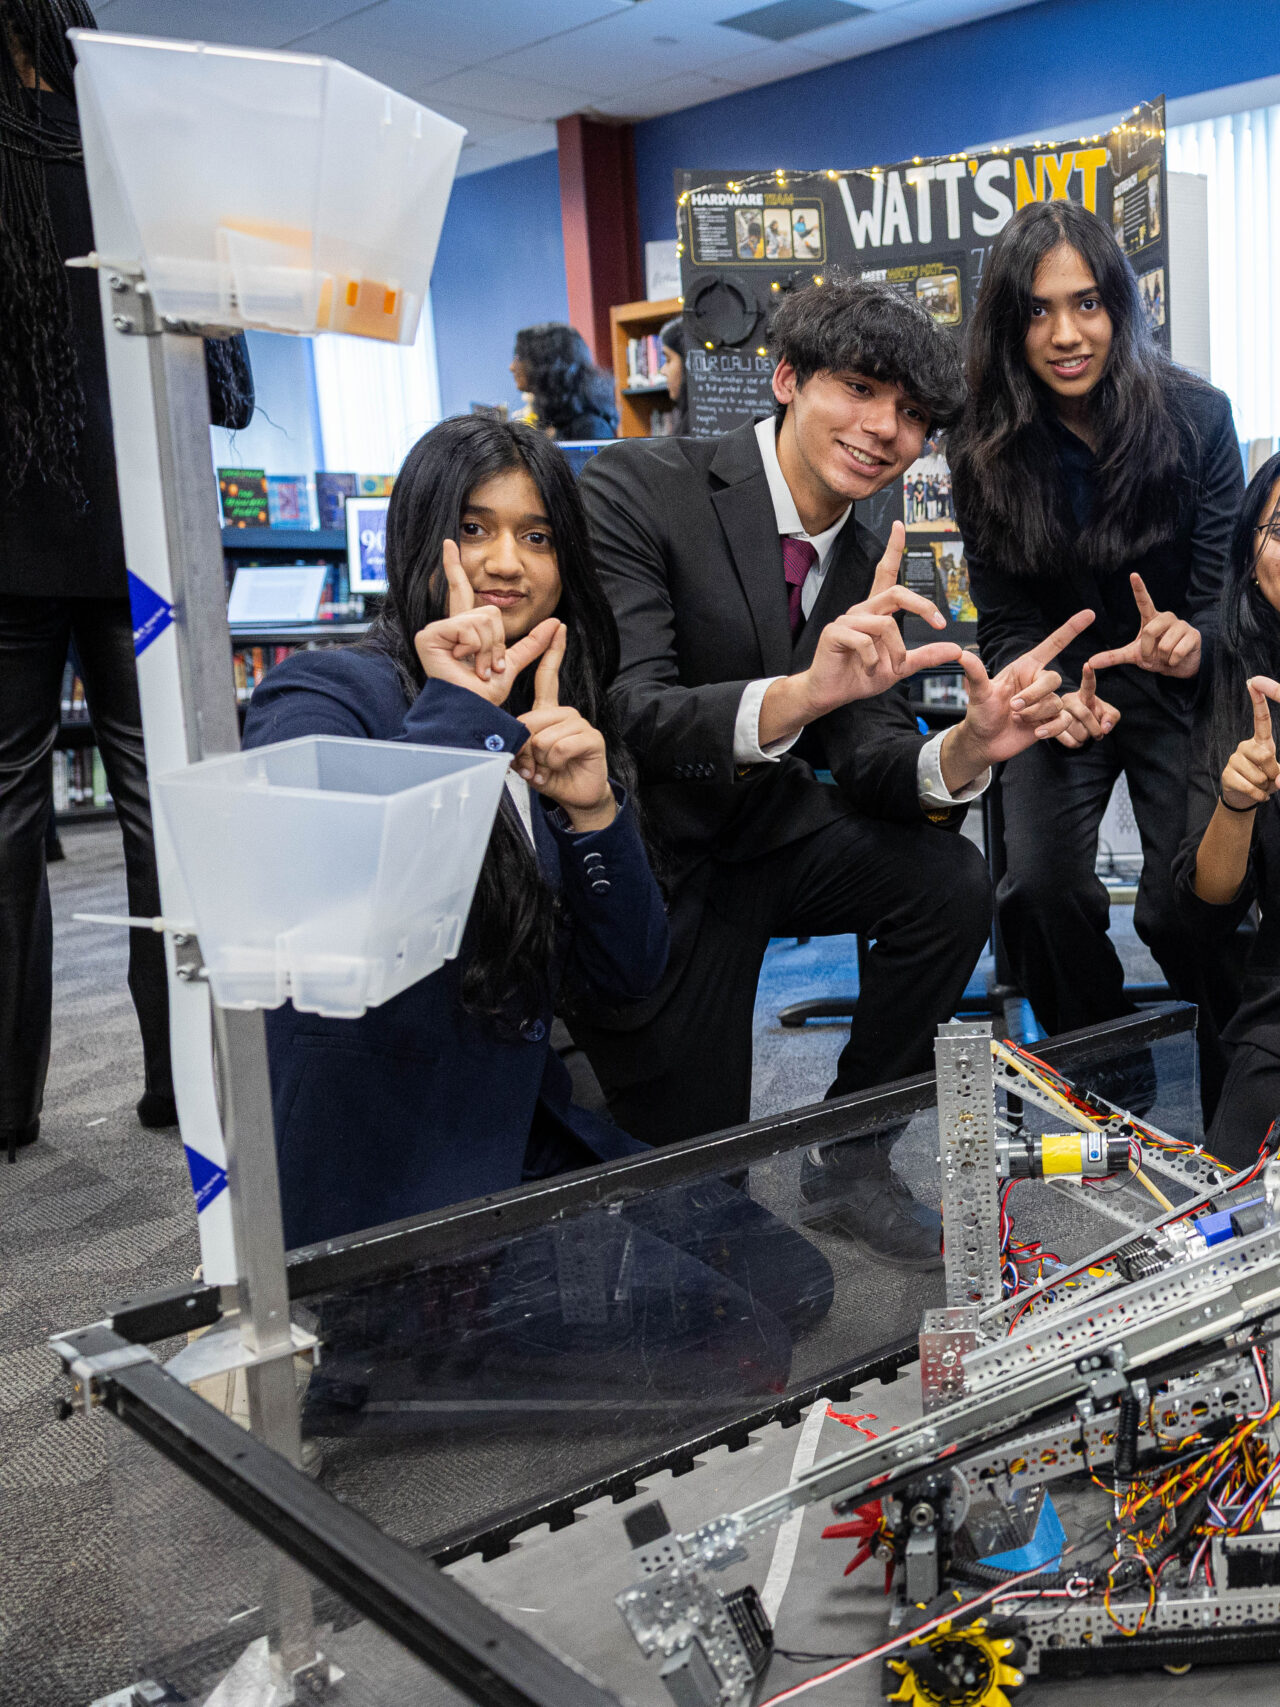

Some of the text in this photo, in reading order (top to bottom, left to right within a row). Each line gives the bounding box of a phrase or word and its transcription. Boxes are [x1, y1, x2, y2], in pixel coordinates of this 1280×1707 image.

[691, 193, 764, 206] HARDWARE
[838, 159, 1013, 249] WATT'S
[1014, 147, 1108, 215] NXT
